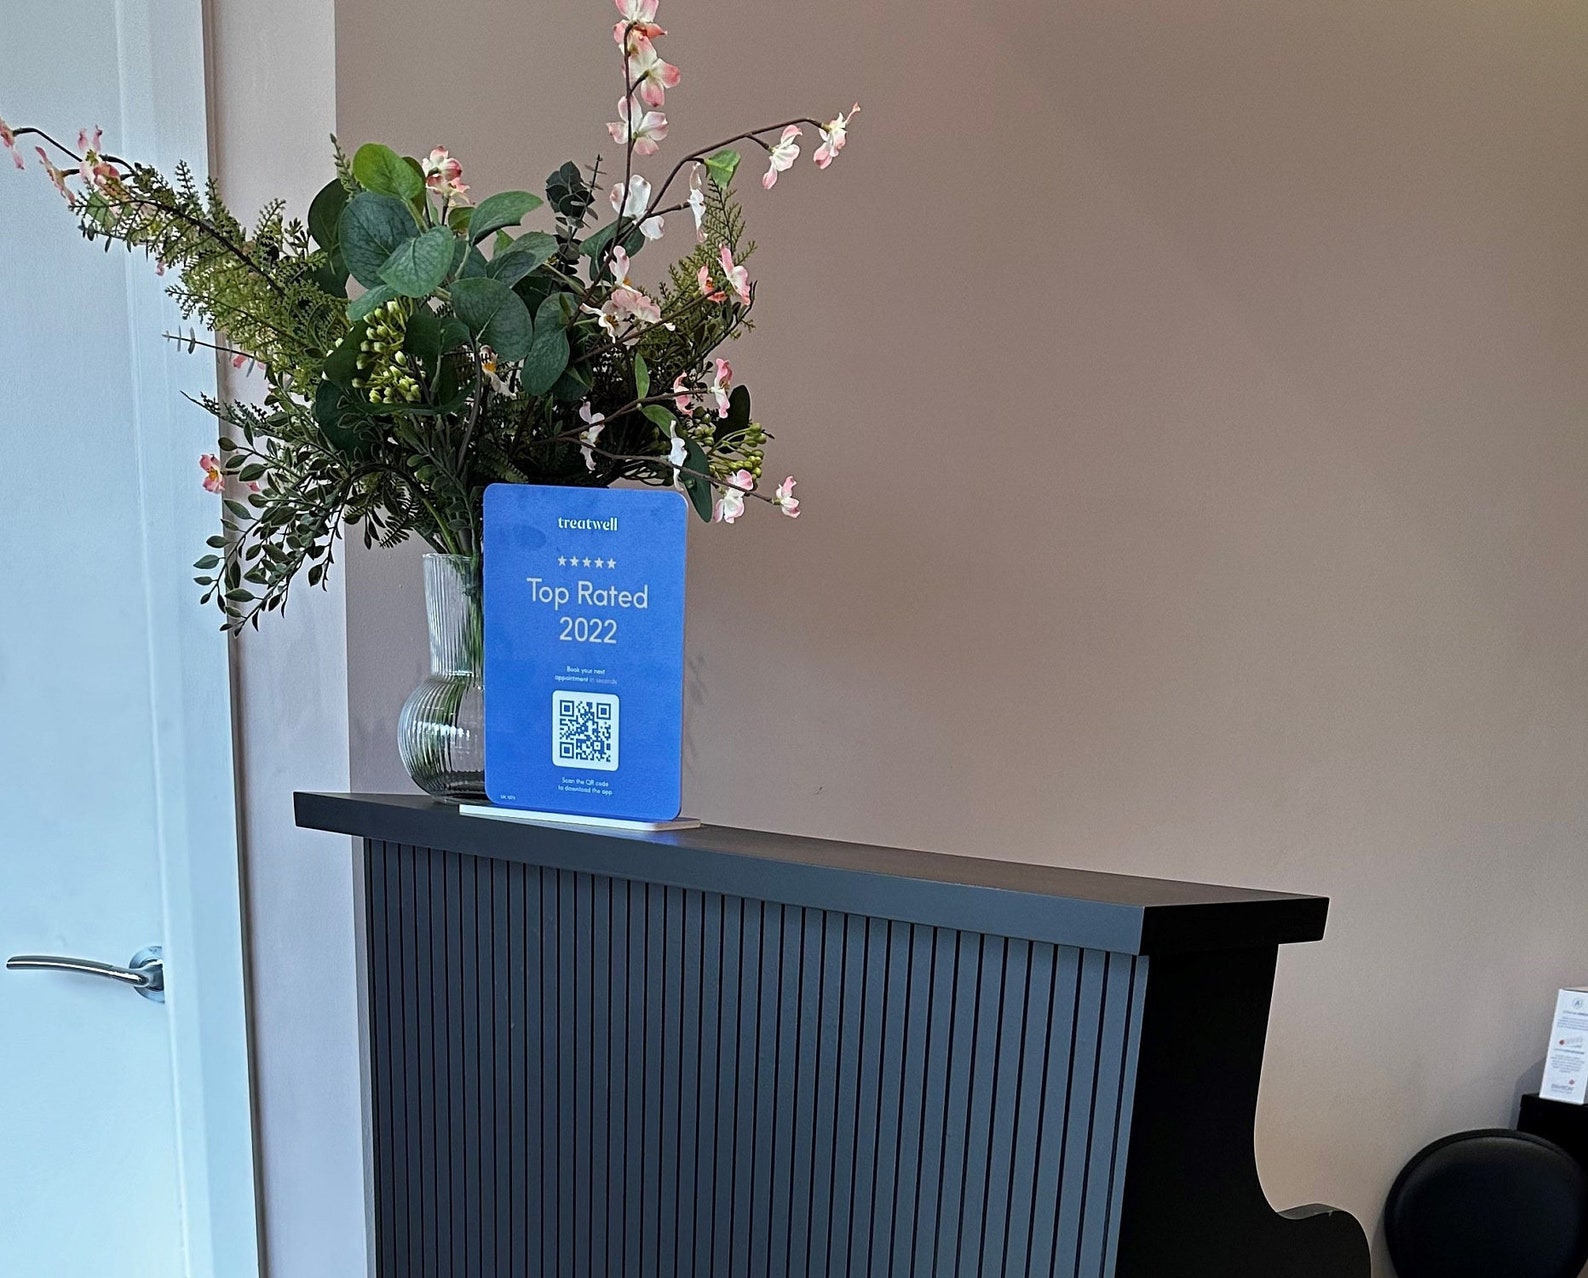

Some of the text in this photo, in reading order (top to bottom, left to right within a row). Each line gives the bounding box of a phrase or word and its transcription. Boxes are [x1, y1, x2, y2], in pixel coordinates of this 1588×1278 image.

[558, 517, 618, 531] treatwell
[526, 577, 648, 611] Top Rated
[559, 616, 618, 644] 2022
[566, 665, 580, 673] Book
[561, 776, 575, 784] Scan
